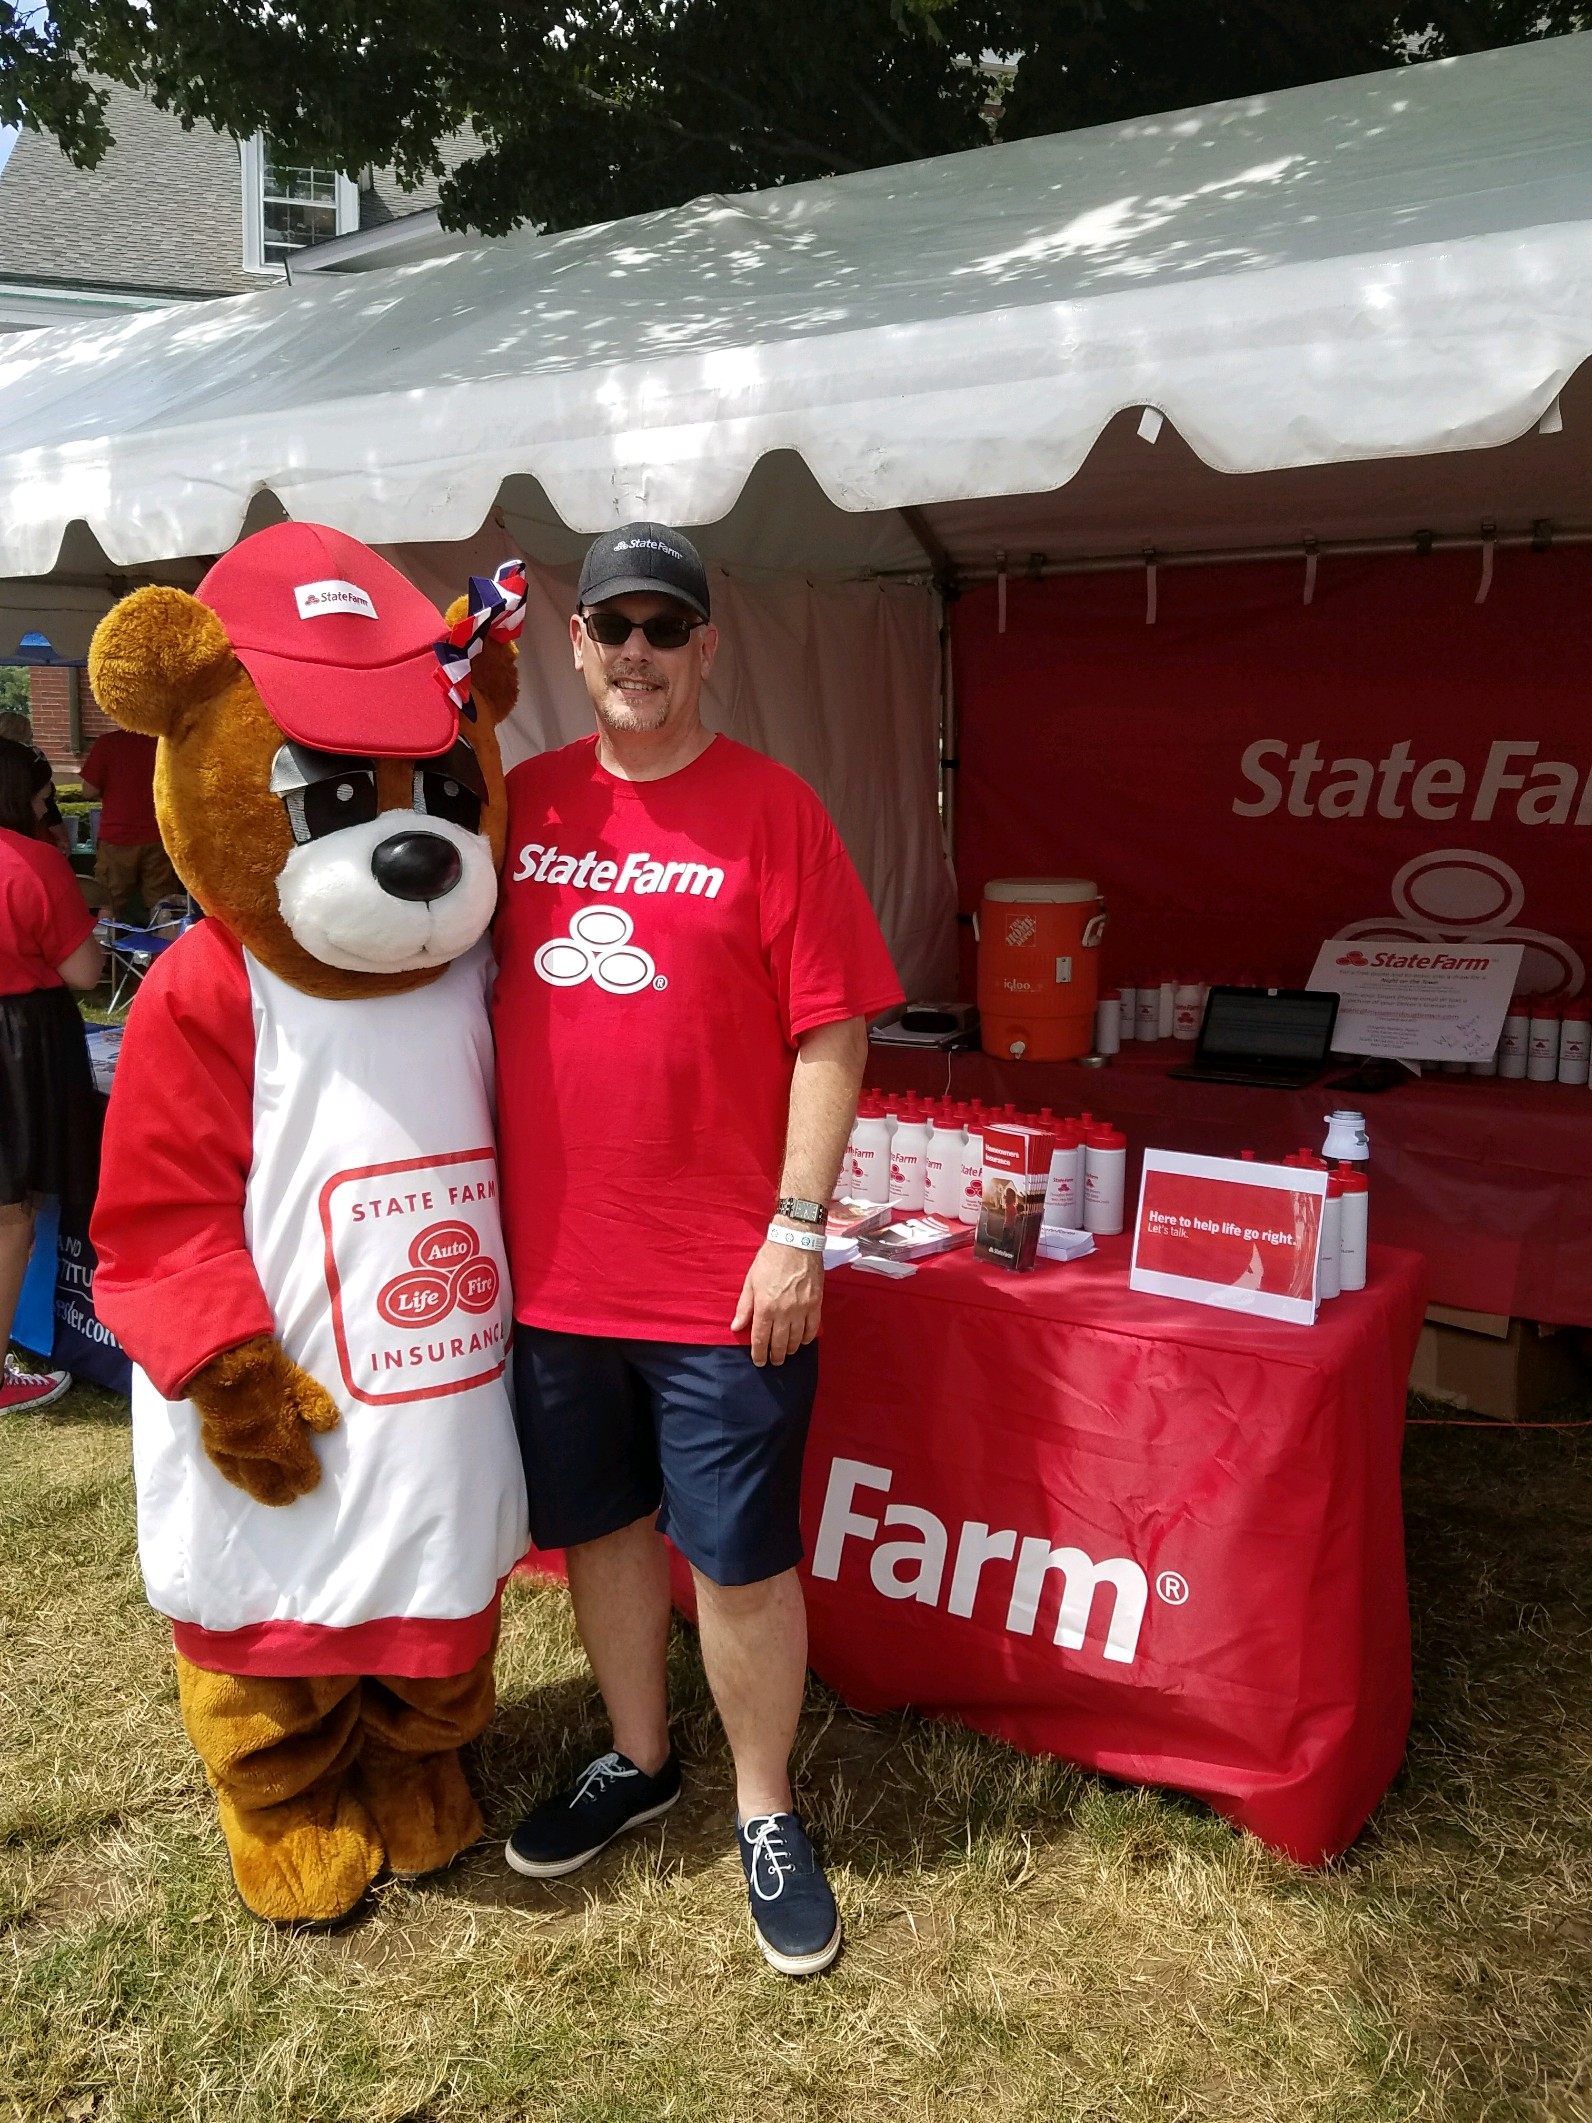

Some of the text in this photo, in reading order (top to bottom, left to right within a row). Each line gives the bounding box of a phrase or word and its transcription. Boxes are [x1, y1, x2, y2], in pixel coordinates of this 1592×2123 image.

[1006, 915, 1036, 946] HOME
[1003, 979, 1031, 990] igloo
[352, 1180, 496, 1222] STATE FARM
[1147, 1223, 1189, 1239] Let's talk.
[1149, 1210, 1297, 1246] Here to help life go right.
[427, 1241, 468, 1261] Auto
[398, 1276, 493, 1313] Life Fire
[811, 1456, 1148, 1665] Farm
